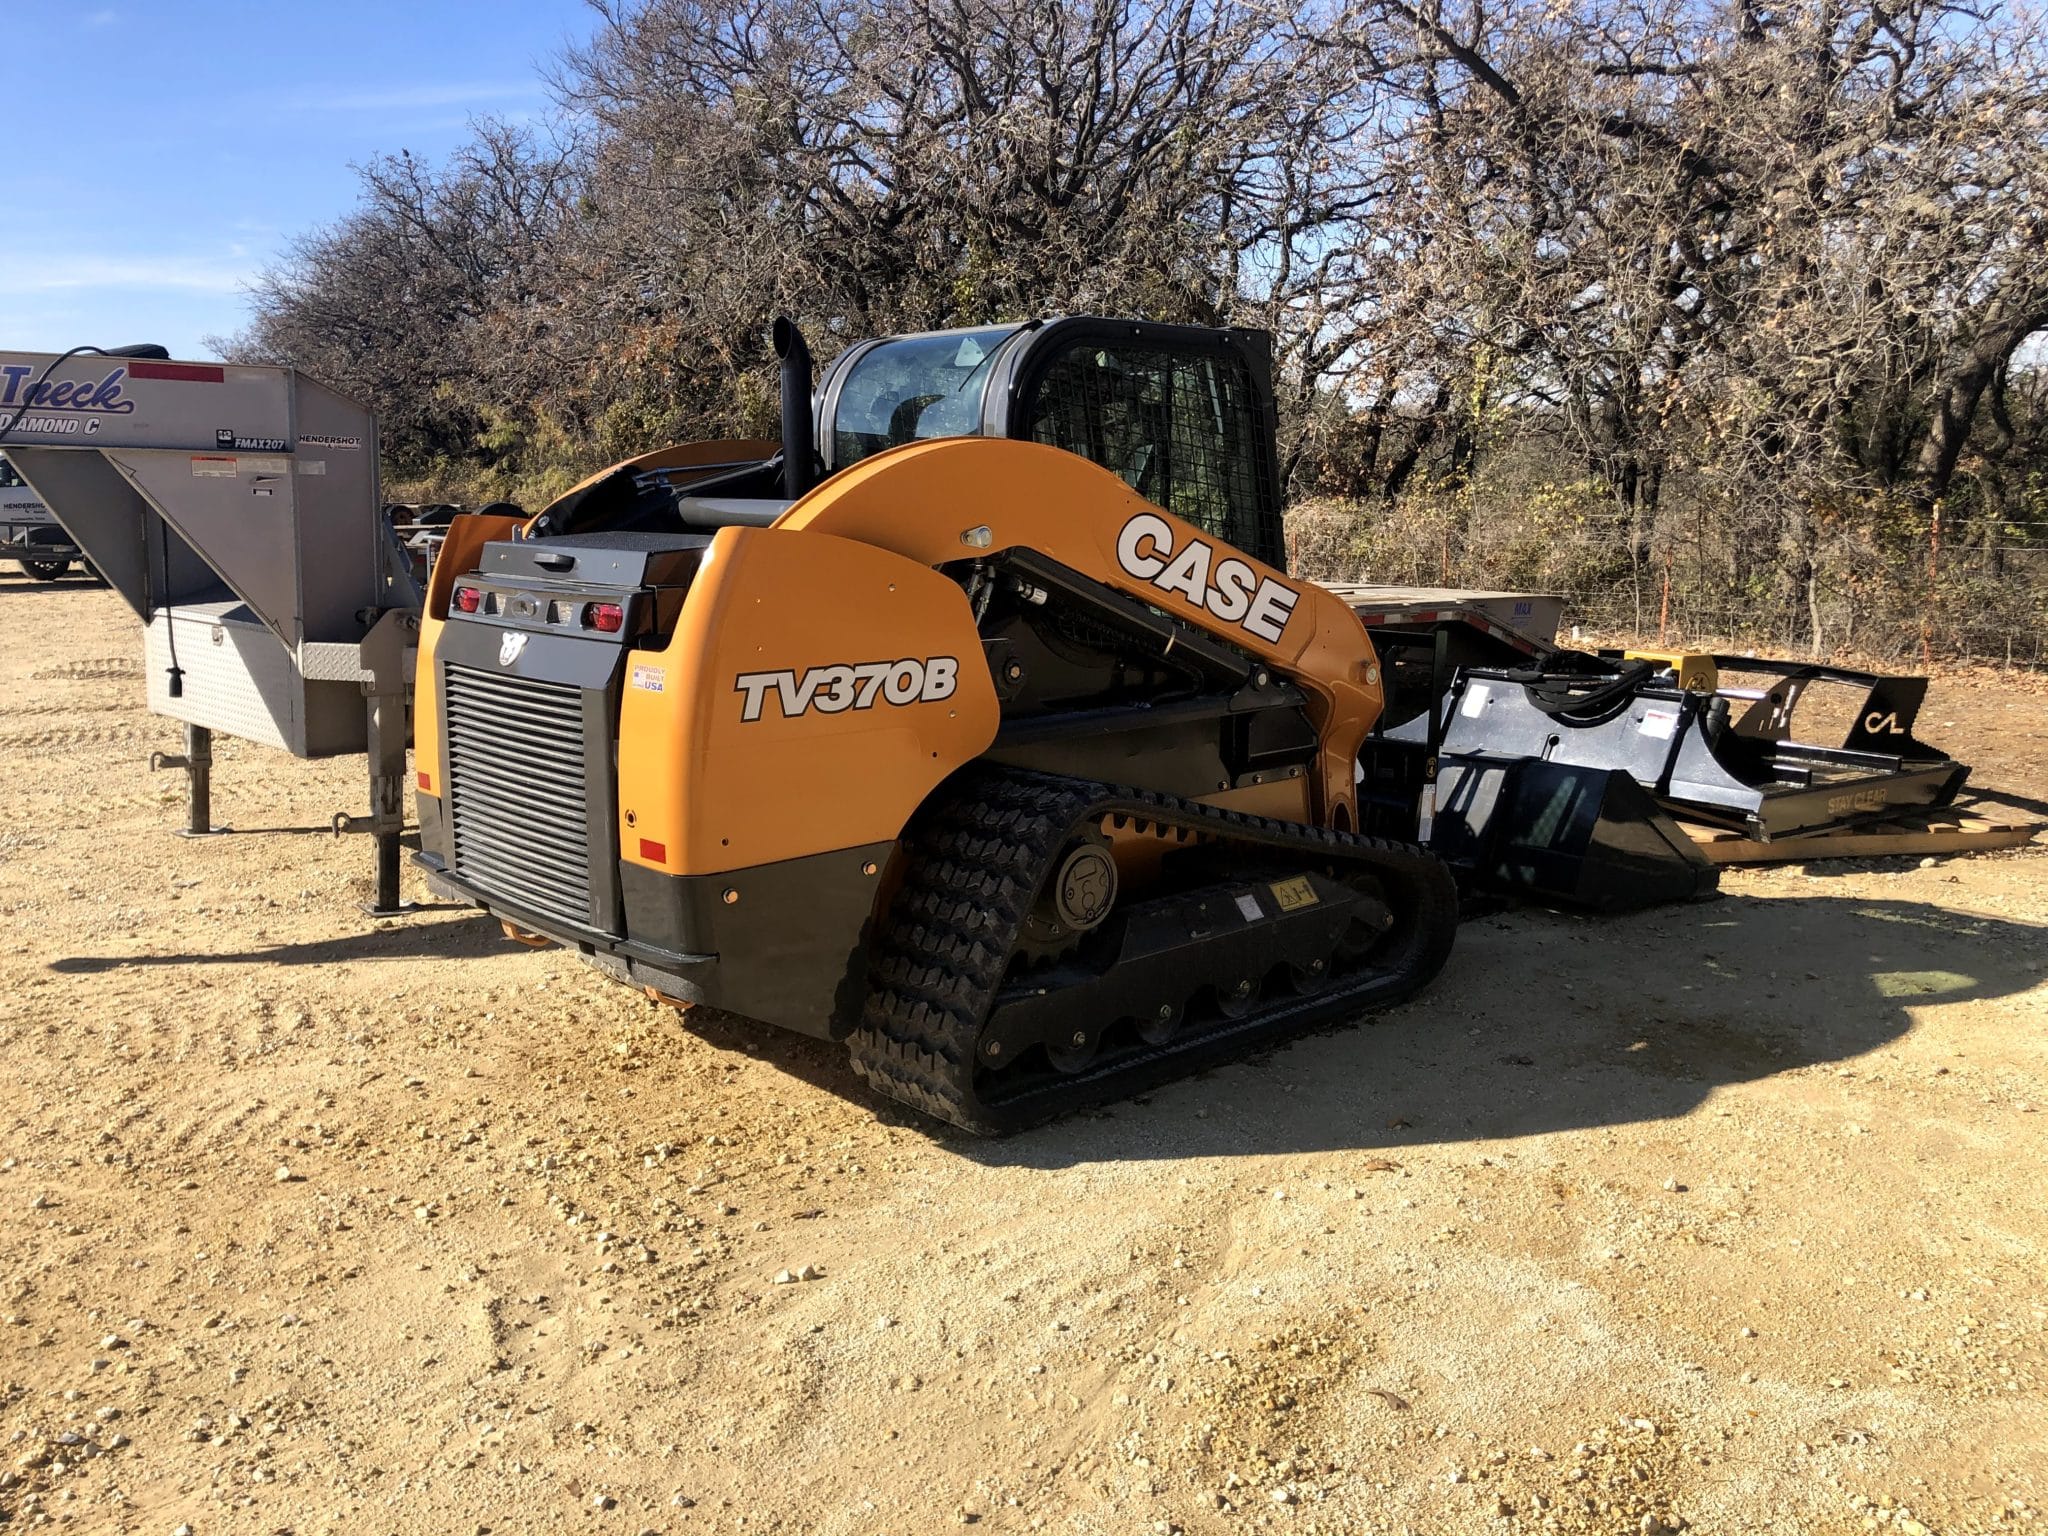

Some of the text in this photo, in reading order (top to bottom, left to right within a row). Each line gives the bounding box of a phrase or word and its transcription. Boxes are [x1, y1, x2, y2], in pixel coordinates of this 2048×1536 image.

[84, 417, 100, 434] C
[234, 438, 285, 450] FMAX207
[299, 434, 361, 445] HENDERSHOT
[1116, 512, 1301, 646] CASE
[644, 681, 664, 691] USA
[734, 656, 959, 723] TV370B
[1828, 795, 1852, 814] STAY
